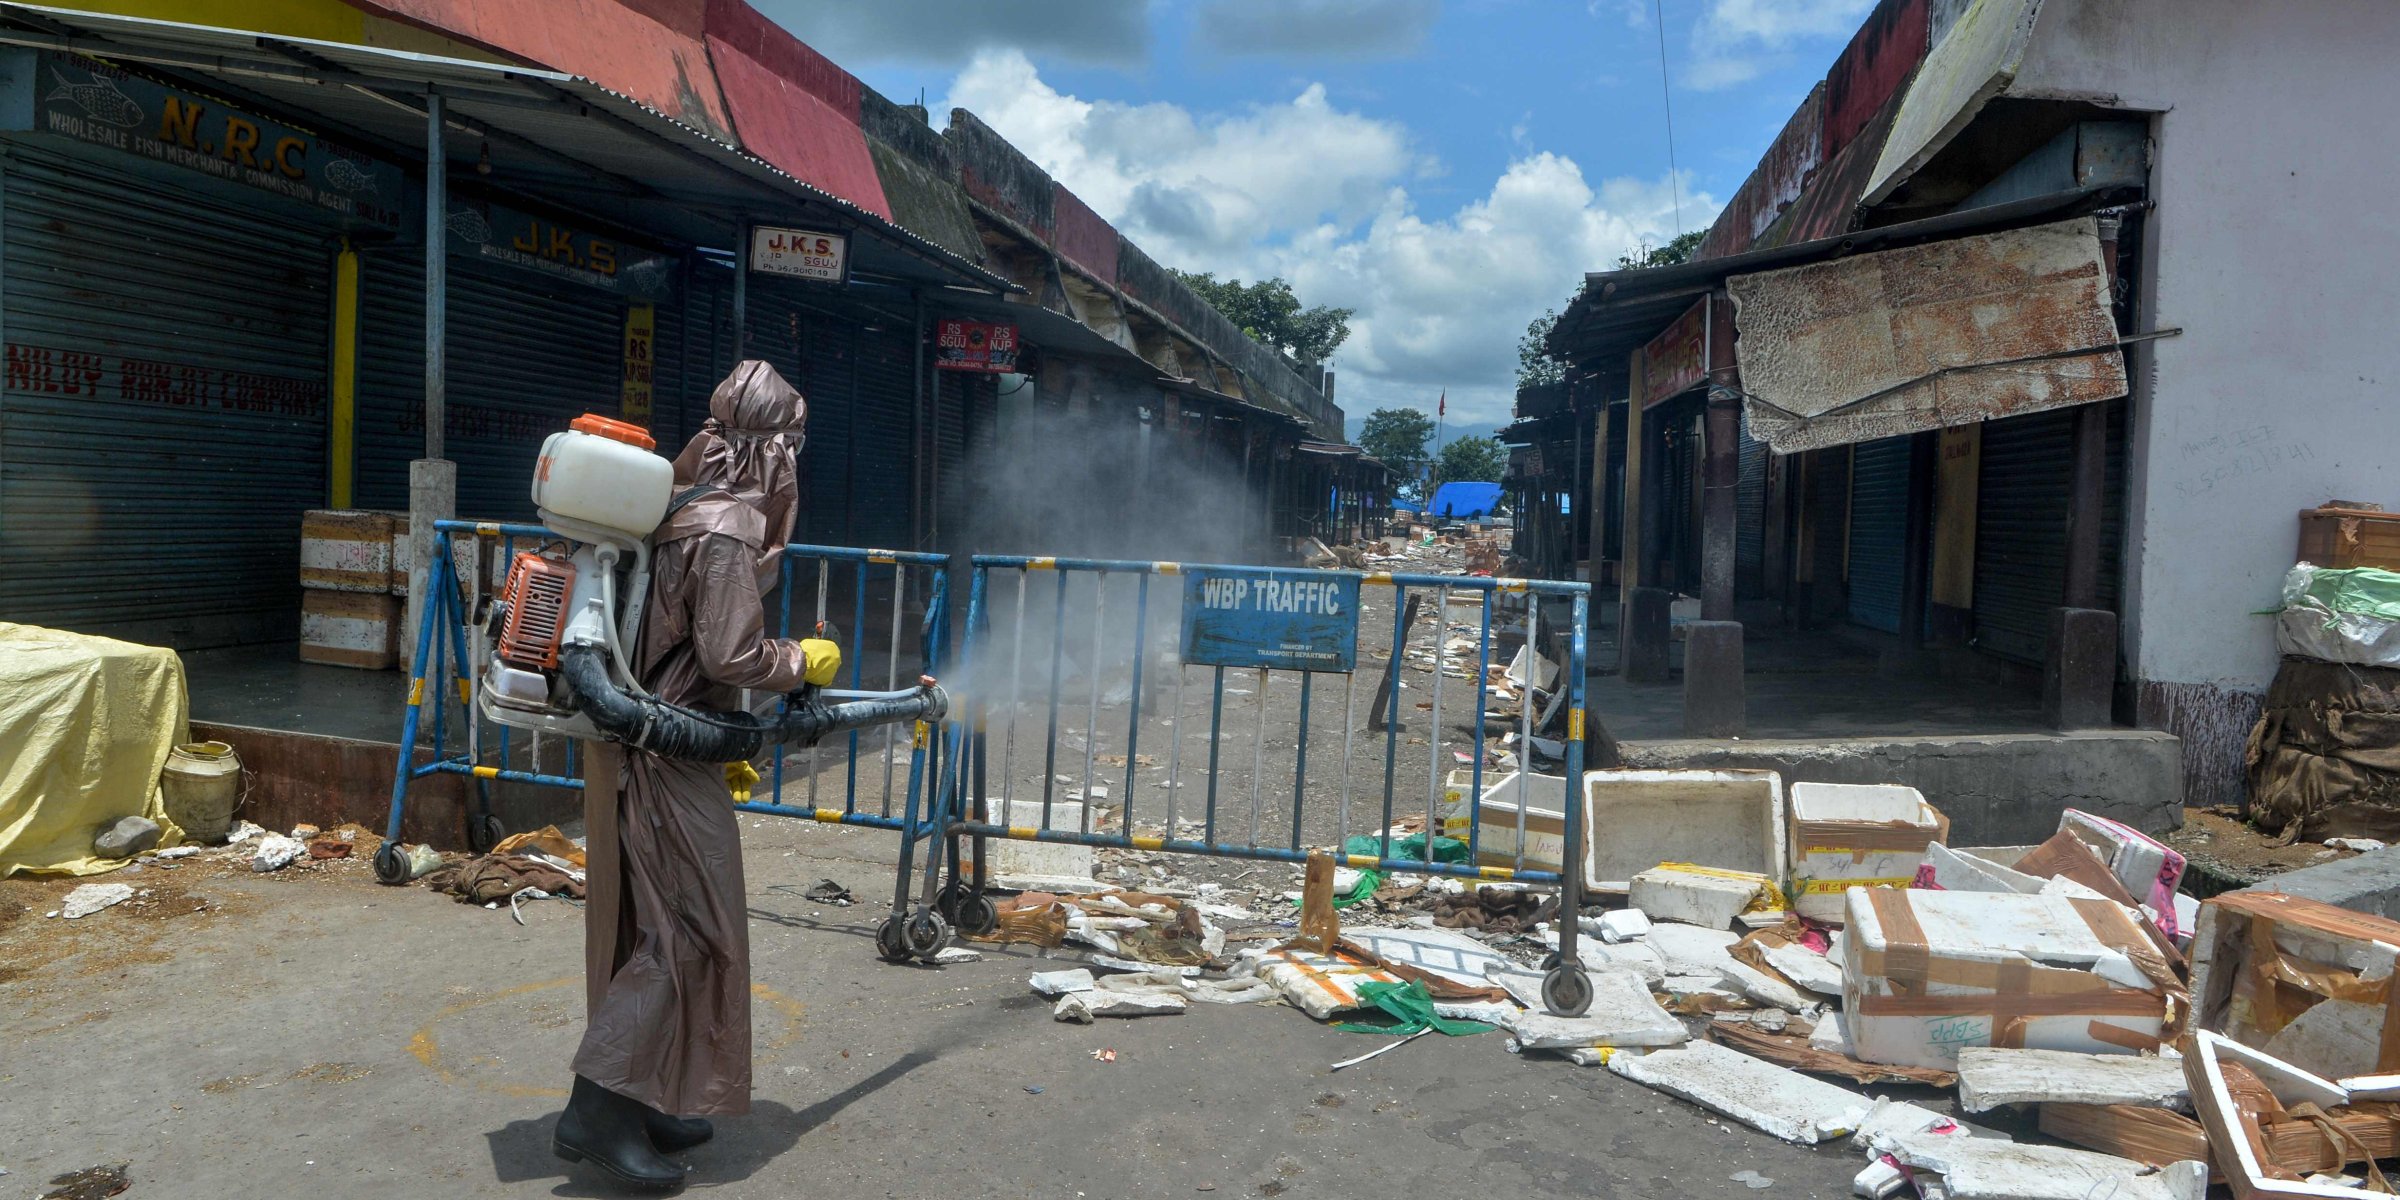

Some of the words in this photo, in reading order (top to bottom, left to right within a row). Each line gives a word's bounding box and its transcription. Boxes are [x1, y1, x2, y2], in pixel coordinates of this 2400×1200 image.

[48, 110, 128, 149] WHOLESALE
[135, 136, 162, 158] FISH
[246, 169, 313, 202] COMMISSION
[318, 191, 351, 214] AGENT
[804, 257, 838, 268] SGUJ
[947, 323, 961, 334] RS
[994, 327, 1010, 338] RS
[629, 338, 647, 359] RS
[940, 336, 967, 348] SGUJ
[990, 340, 1012, 351] NJP
[1203, 578, 1248, 610] WBP
[1253, 579, 1340, 615] TRAFFIC
[1257, 649, 1294, 658] TRANSPORT
[1294, 651, 1336, 660] DEPARTMENT
